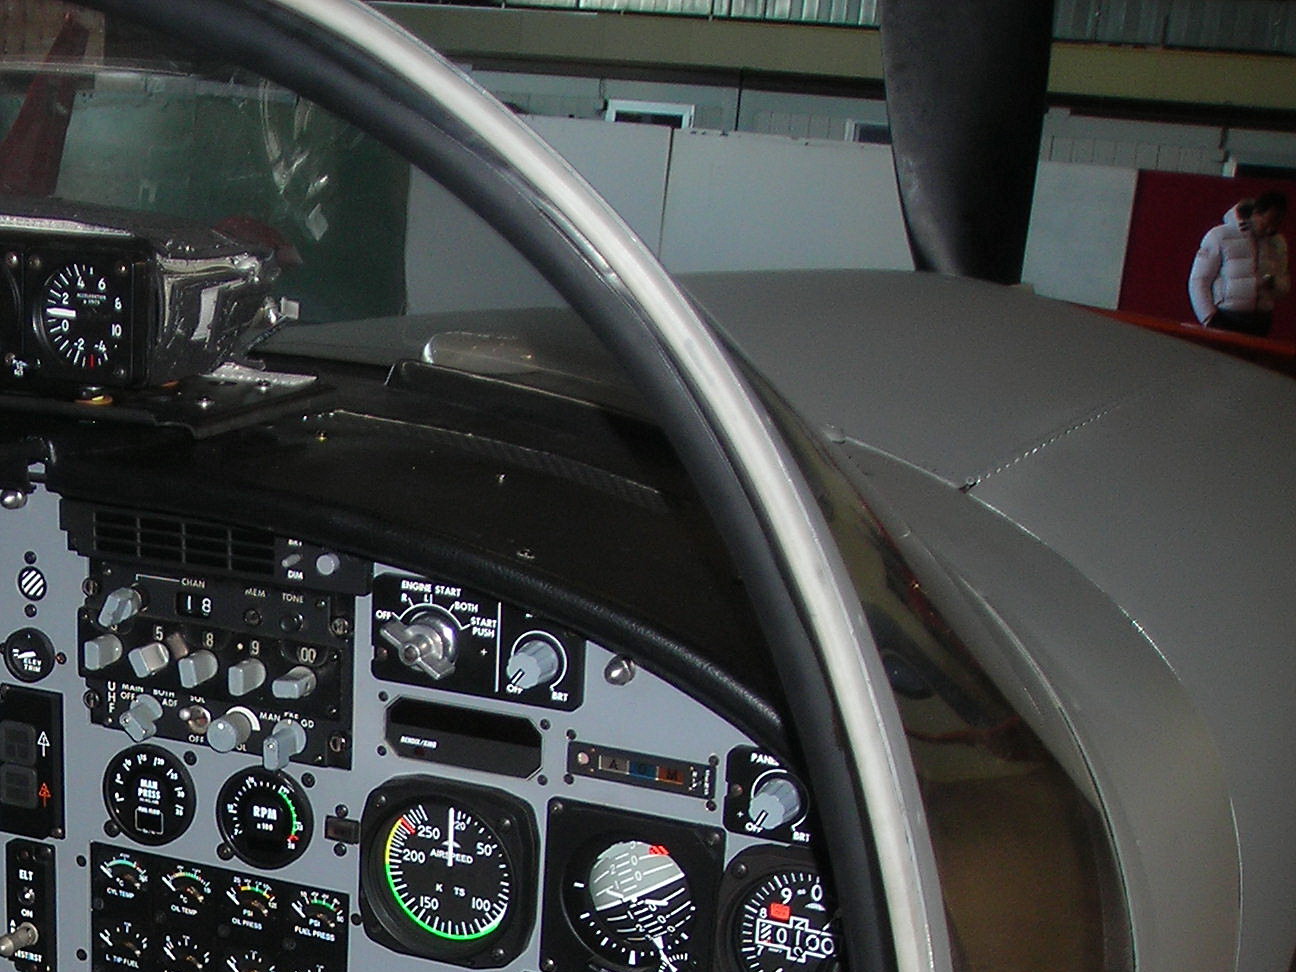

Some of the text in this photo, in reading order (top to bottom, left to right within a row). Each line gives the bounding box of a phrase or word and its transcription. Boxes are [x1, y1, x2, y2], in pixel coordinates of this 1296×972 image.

[111, 322, 123, 337] 10
[287, 570, 304, 581] DIM
[180, 577, 205, 589] CHAN
[401, 579, 462, 599] ENGINE START
[244, 588, 266, 598] MEM
[281, 592, 304, 604] TONE
[453, 600, 479, 614] BOTH
[375, 609, 392, 620] OFF
[470, 616, 497, 629] START
[155, 626, 164, 642] 5
[472, 627, 495, 639] PUSH
[300, 646, 317, 662] 00
[23, 657, 42, 667] ELEV
[23, 663, 41, 673] TRIM
[121, 682, 145, 693] MAIN
[506, 684, 523, 696] OFF
[120, 691, 136, 701] OFF
[551, 691, 569, 704] BRT
[161, 698, 178, 708] ADF
[259, 711, 281, 723] MAN
[300, 719, 315, 729] GD
[188, 734, 205, 744] OFF
[140, 778, 159, 790] MAN
[137, 787, 161, 800] PRESS
[252, 805, 278, 821] RPM
[454, 821, 467, 831] 20
[745, 822, 764, 834] OFF
[417, 825, 441, 841] 250
[792, 831, 811, 844] BRT
[402, 848, 426, 864] 200
[476, 842, 492, 858] 50
[18, 868, 34, 882] ELT
[118, 889, 135, 899] TEMP
[453, 886, 466, 897] TS
[780, 887, 792, 905] 9
[811, 884, 823, 902] 0
[419, 895, 439, 911] 150
[471, 897, 491, 911] 100
[20, 908, 34, 919] ON
[181, 906, 198, 916] TEMP
[759, 907, 768, 919] 8
[242, 919, 263, 931] PRESS
[308, 918, 321, 928] PSI
[294, 925, 335, 942] FUEL PRESS
[112, 956, 140, 969] TIP FUEL
